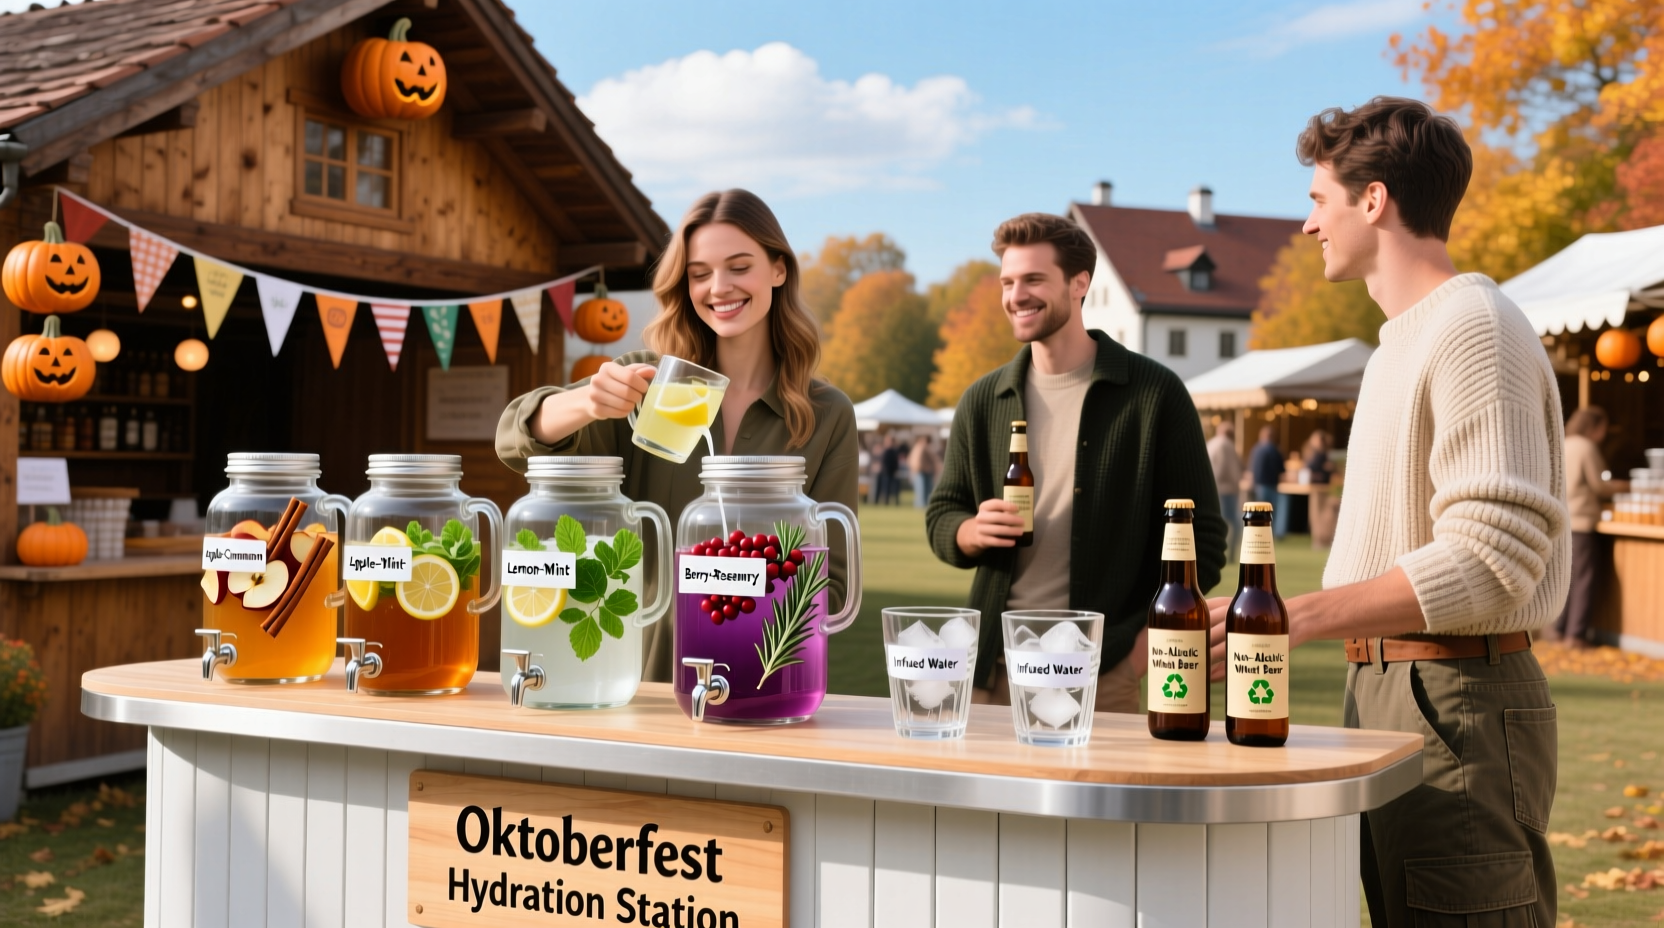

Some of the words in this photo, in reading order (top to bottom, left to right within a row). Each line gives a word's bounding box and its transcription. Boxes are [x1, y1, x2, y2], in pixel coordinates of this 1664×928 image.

[507, 562, 571, 576] Lemon-Mint
[456, 805, 723, 883] Oktoberfest
[448, 867, 605, 920] Hydration
[616, 887, 739, 928] Station
